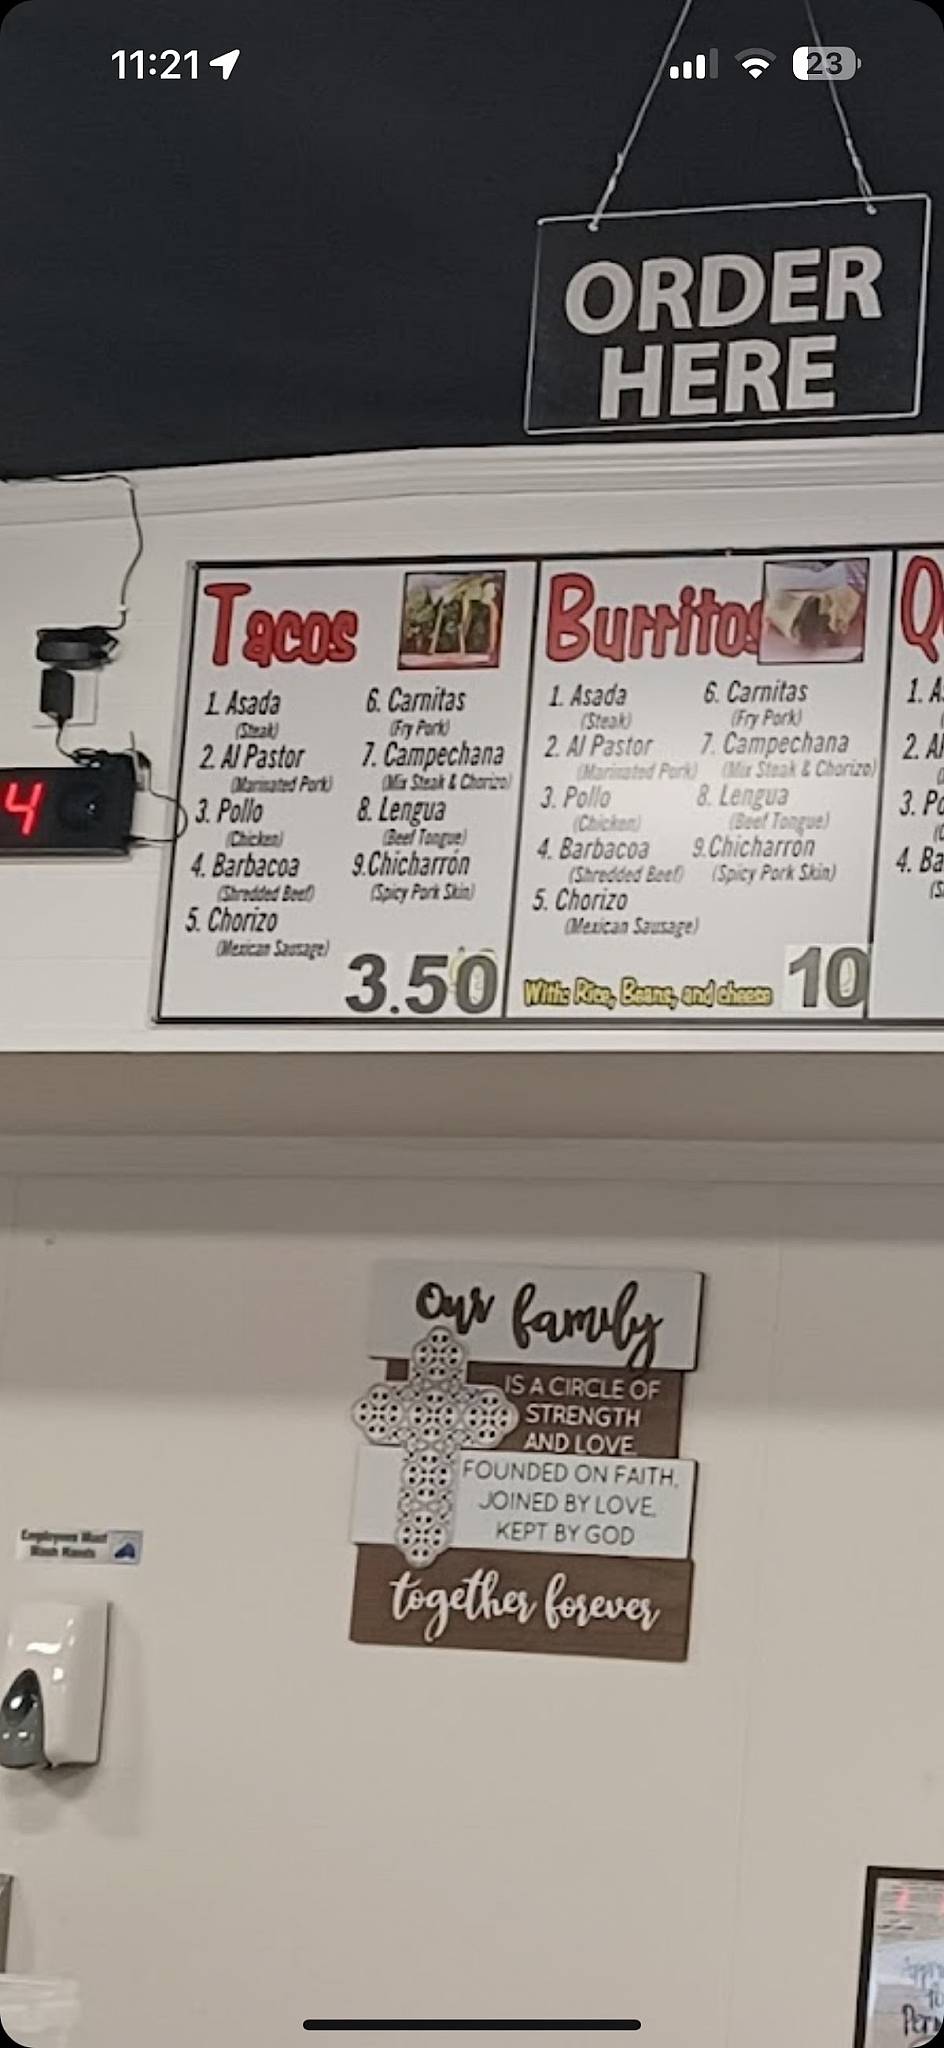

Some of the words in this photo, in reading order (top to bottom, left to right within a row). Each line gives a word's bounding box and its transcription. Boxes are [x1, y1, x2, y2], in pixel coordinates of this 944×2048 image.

[565, 245, 883, 335] ORDER
[599, 335, 837, 420] HERE
[901, 555, 944, 664] Q
[203, 582, 359, 668] Tacos
[224, 689, 281, 715] Asada
[366, 686, 381, 713] 6.
[387, 685, 467, 713] Carnitas
[548, 684, 564, 707] 1.
[569, 682, 628, 707] Asada
[703, 680, 720, 704] 6.
[726, 679, 809, 704] Carnitas
[906, 677, 922, 703] 1.
[929, 676, 944, 703] A
[235, 721, 280, 740] (Steak)
[580, 711, 633, 730] (Steak)
[762, 707, 803, 727] Pork)
[220, 743, 242, 769] Al
[243, 743, 306, 769] Pastor
[361, 741, 377, 767] 7.
[383, 739, 505, 771] Campechana
[544, 734, 560, 758] 2.
[566, 733, 587, 757] Al
[589, 733, 654, 757] Pastor
[700, 731, 716, 755] 7.
[723, 729, 849, 759] Campechana
[902, 732, 919, 760] 2.
[756, 759, 797, 778] Steak
[801, 760, 811, 778] &
[4, 782, 44, 837] 4
[540, 785, 556, 809] 3.
[562, 784, 612, 809] Pollo
[696, 783, 712, 807] 8.
[718, 783, 789, 811] Lengua
[899, 789, 915, 816] 3.
[195, 797, 210, 824] 3.
[216, 797, 263, 824] Pollo
[357, 795, 372, 822] 8.
[378, 795, 447, 827] Lengua
[536, 837, 552, 860] 4.
[559, 836, 650, 860] Barbacoa
[895, 845, 911, 873] 4.
[190, 852, 206, 878] 4.
[212, 851, 300, 878] Barbacoa
[712, 863, 757, 885] (Spicy
[760, 862, 796, 882] Pork
[798, 862, 837, 882] Skin)
[411, 883, 441, 901] Pork
[532, 887, 548, 911] 5.
[555, 887, 629, 911] Chorizo
[184, 906, 201, 932] 5.
[208, 905, 279, 932] Chorizo
[344, 953, 499, 1015] 3.50
[788, 945, 870, 1008] 10
[574, 976, 618, 1010] Rice,
[620, 976, 679, 1010] Beans,
[681, 978, 716, 1007] and
[716, 979, 773, 1006] cheese
[415, 1281, 495, 1335] Our
[511, 1280, 663, 1374] family
[504, 1374, 525, 1395] IS
[529, 1377, 545, 1396] A
[549, 1376, 625, 1400] CIRCLE
[629, 1378, 661, 1400] OF
[525, 1403, 641, 1428] STRENGTH
[523, 1432, 569, 1453] AND
[463, 1459, 568, 1483] FOUNDED
[574, 1463, 608, 1483] ON
[479, 1490, 559, 1513] JOINED
[564, 1492, 593, 1513] BY
[496, 1521, 548, 1541] KEPT
[555, 1522, 581, 1543] BY
[585, 1524, 635, 1546] GOD
[388, 1567, 537, 1643] together
[544, 1572, 660, 1633] forever
